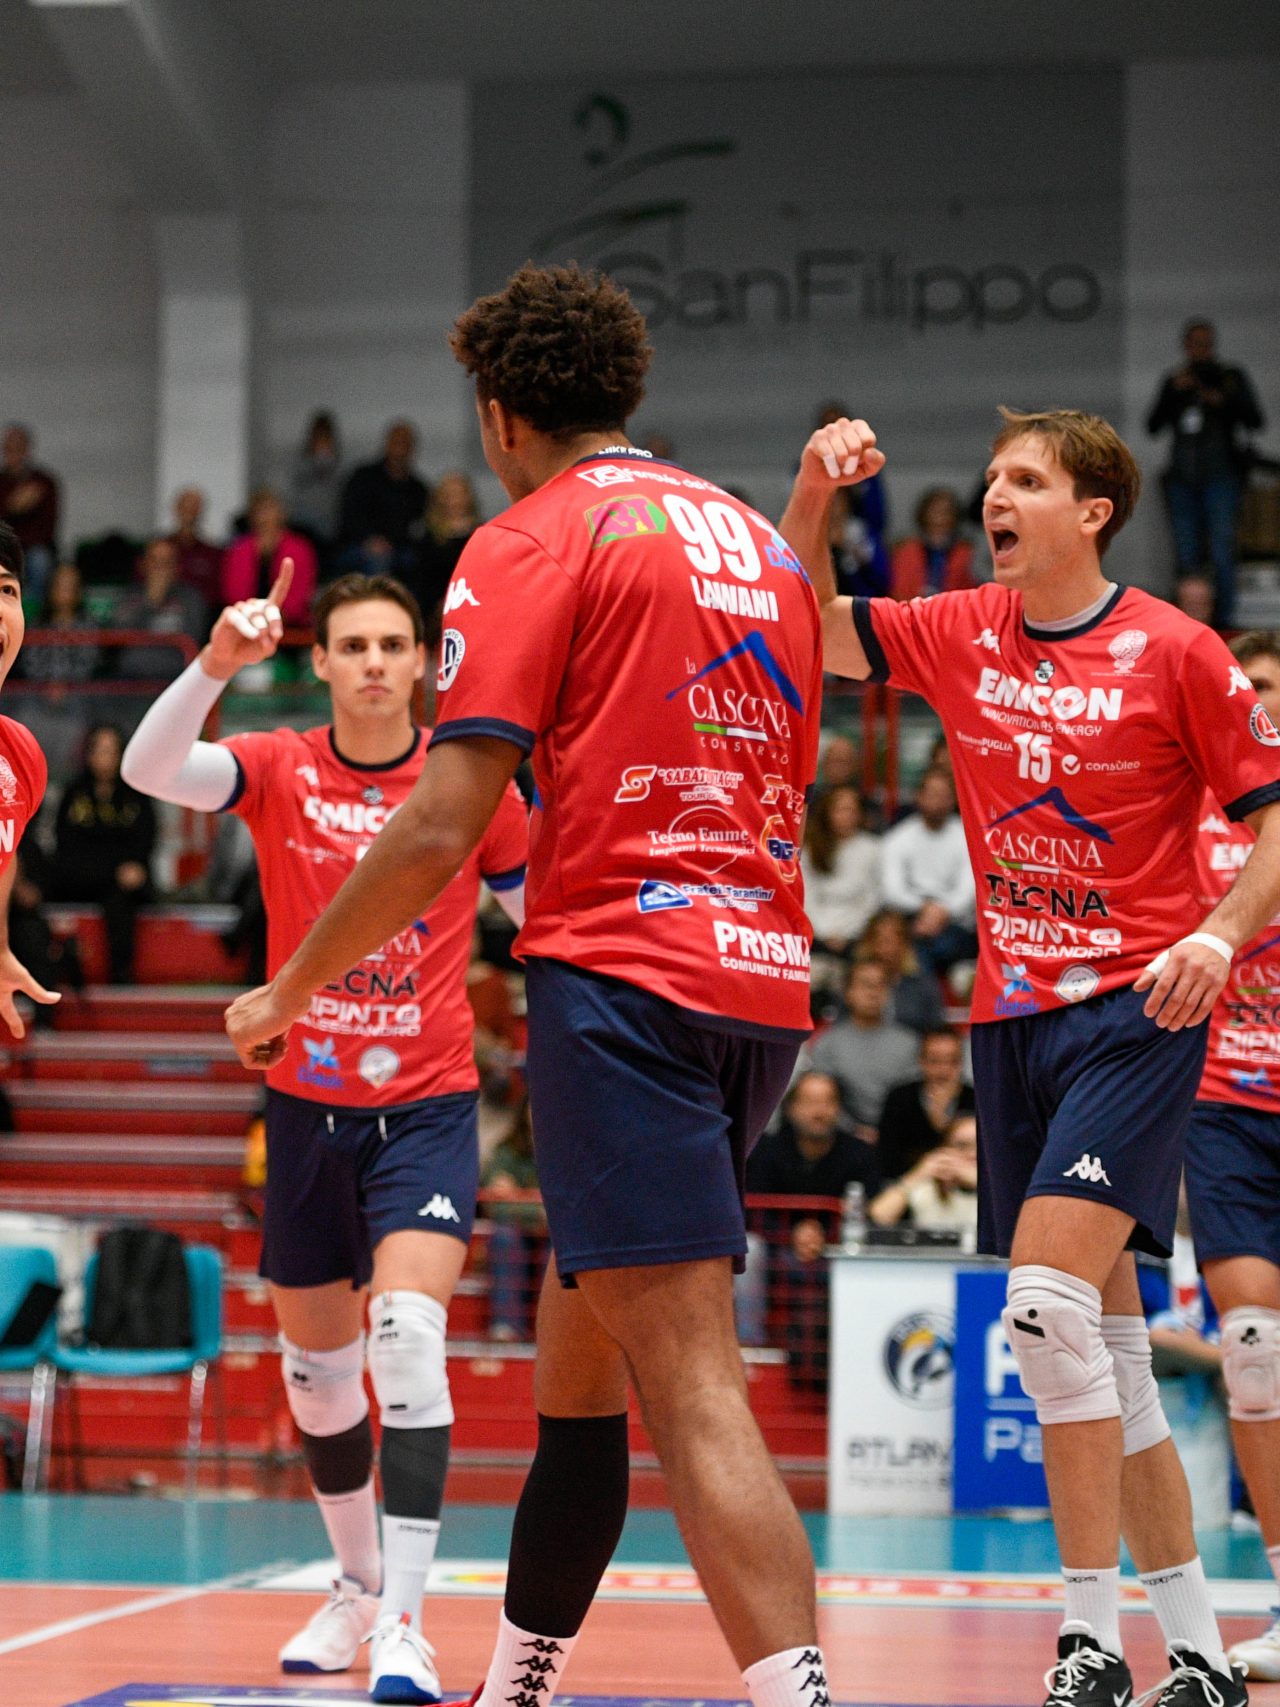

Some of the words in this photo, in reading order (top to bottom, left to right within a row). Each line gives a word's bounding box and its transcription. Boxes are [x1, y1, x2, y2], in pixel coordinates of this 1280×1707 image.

[662, 494, 762, 582] 99
[690, 576, 779, 621] LAWANI
[974, 666, 1123, 721] EMICON
[1055, 722, 1102, 736] ENERGY
[1013, 731, 1053, 784] 15
[648, 831, 696, 845] Tecno
[699, 827, 749, 842] Emme
[985, 828, 1105, 868] CASCINA
